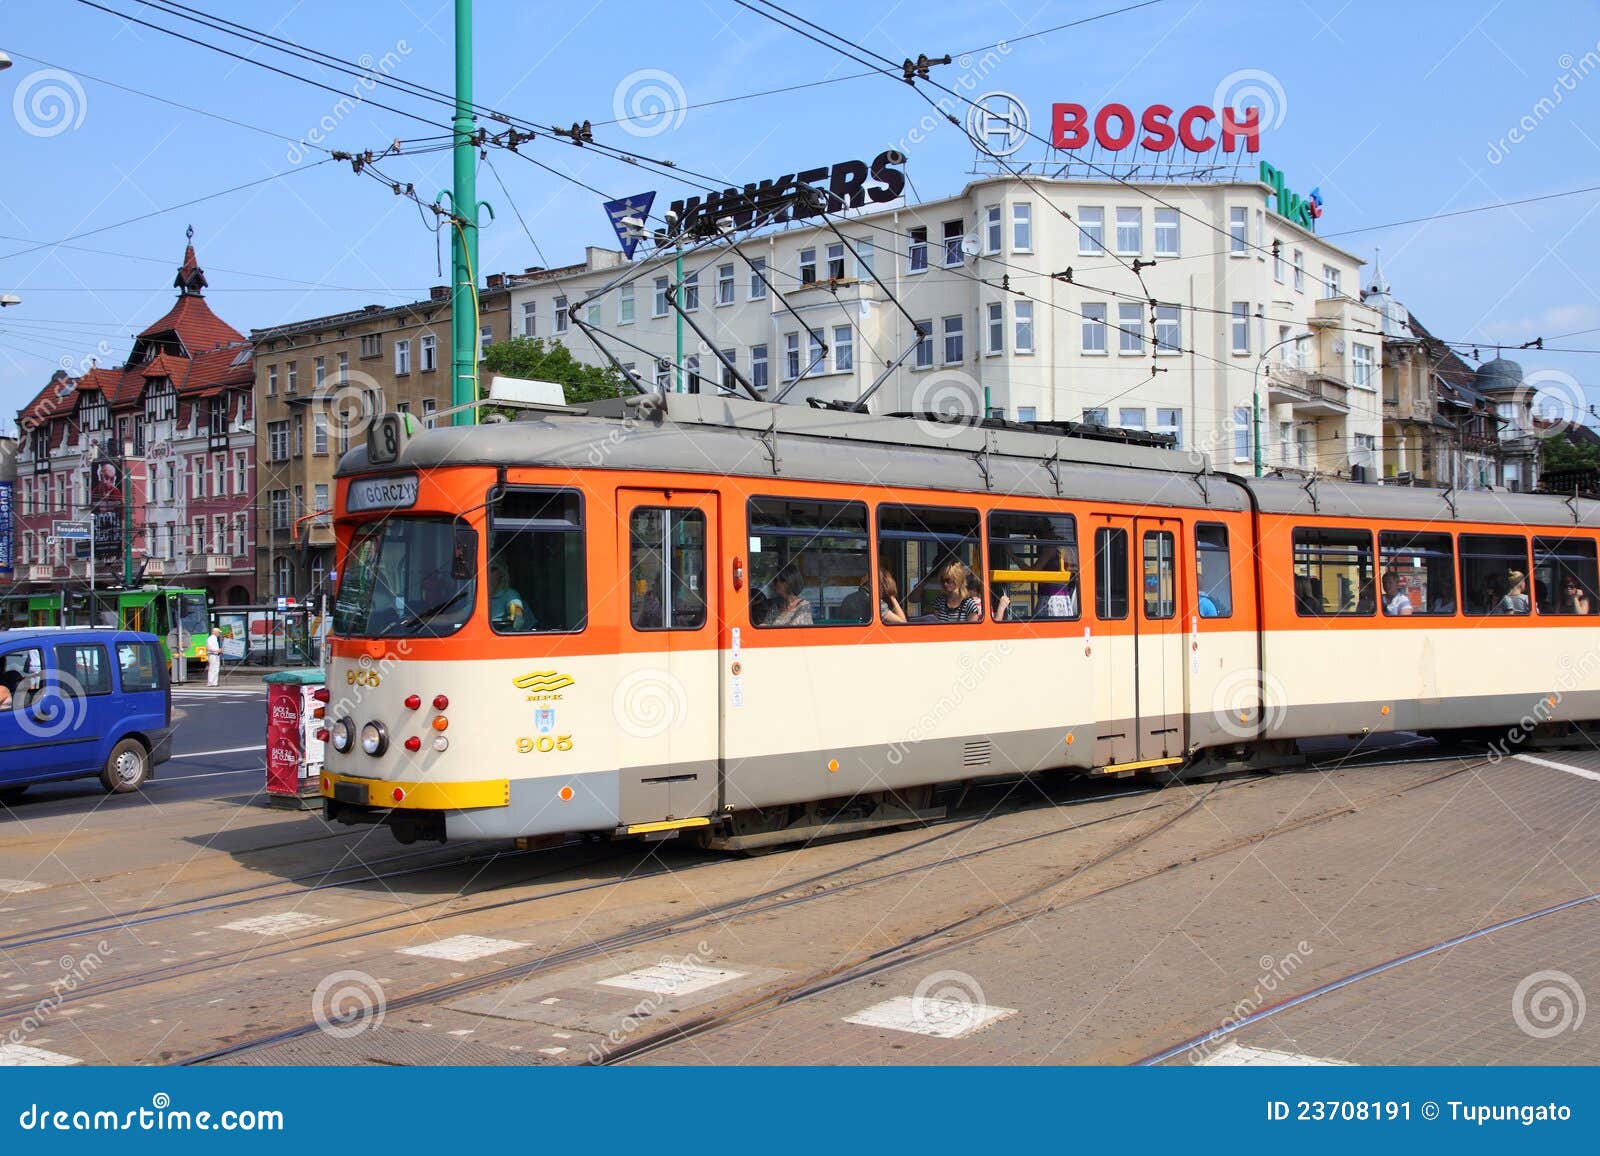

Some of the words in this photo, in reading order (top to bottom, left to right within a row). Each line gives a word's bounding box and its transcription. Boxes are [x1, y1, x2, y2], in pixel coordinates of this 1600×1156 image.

[1051, 102, 1260, 153] BOSCH
[383, 424, 396, 454] 8
[345, 669, 380, 688] 905
[514, 734, 574, 754] 905
